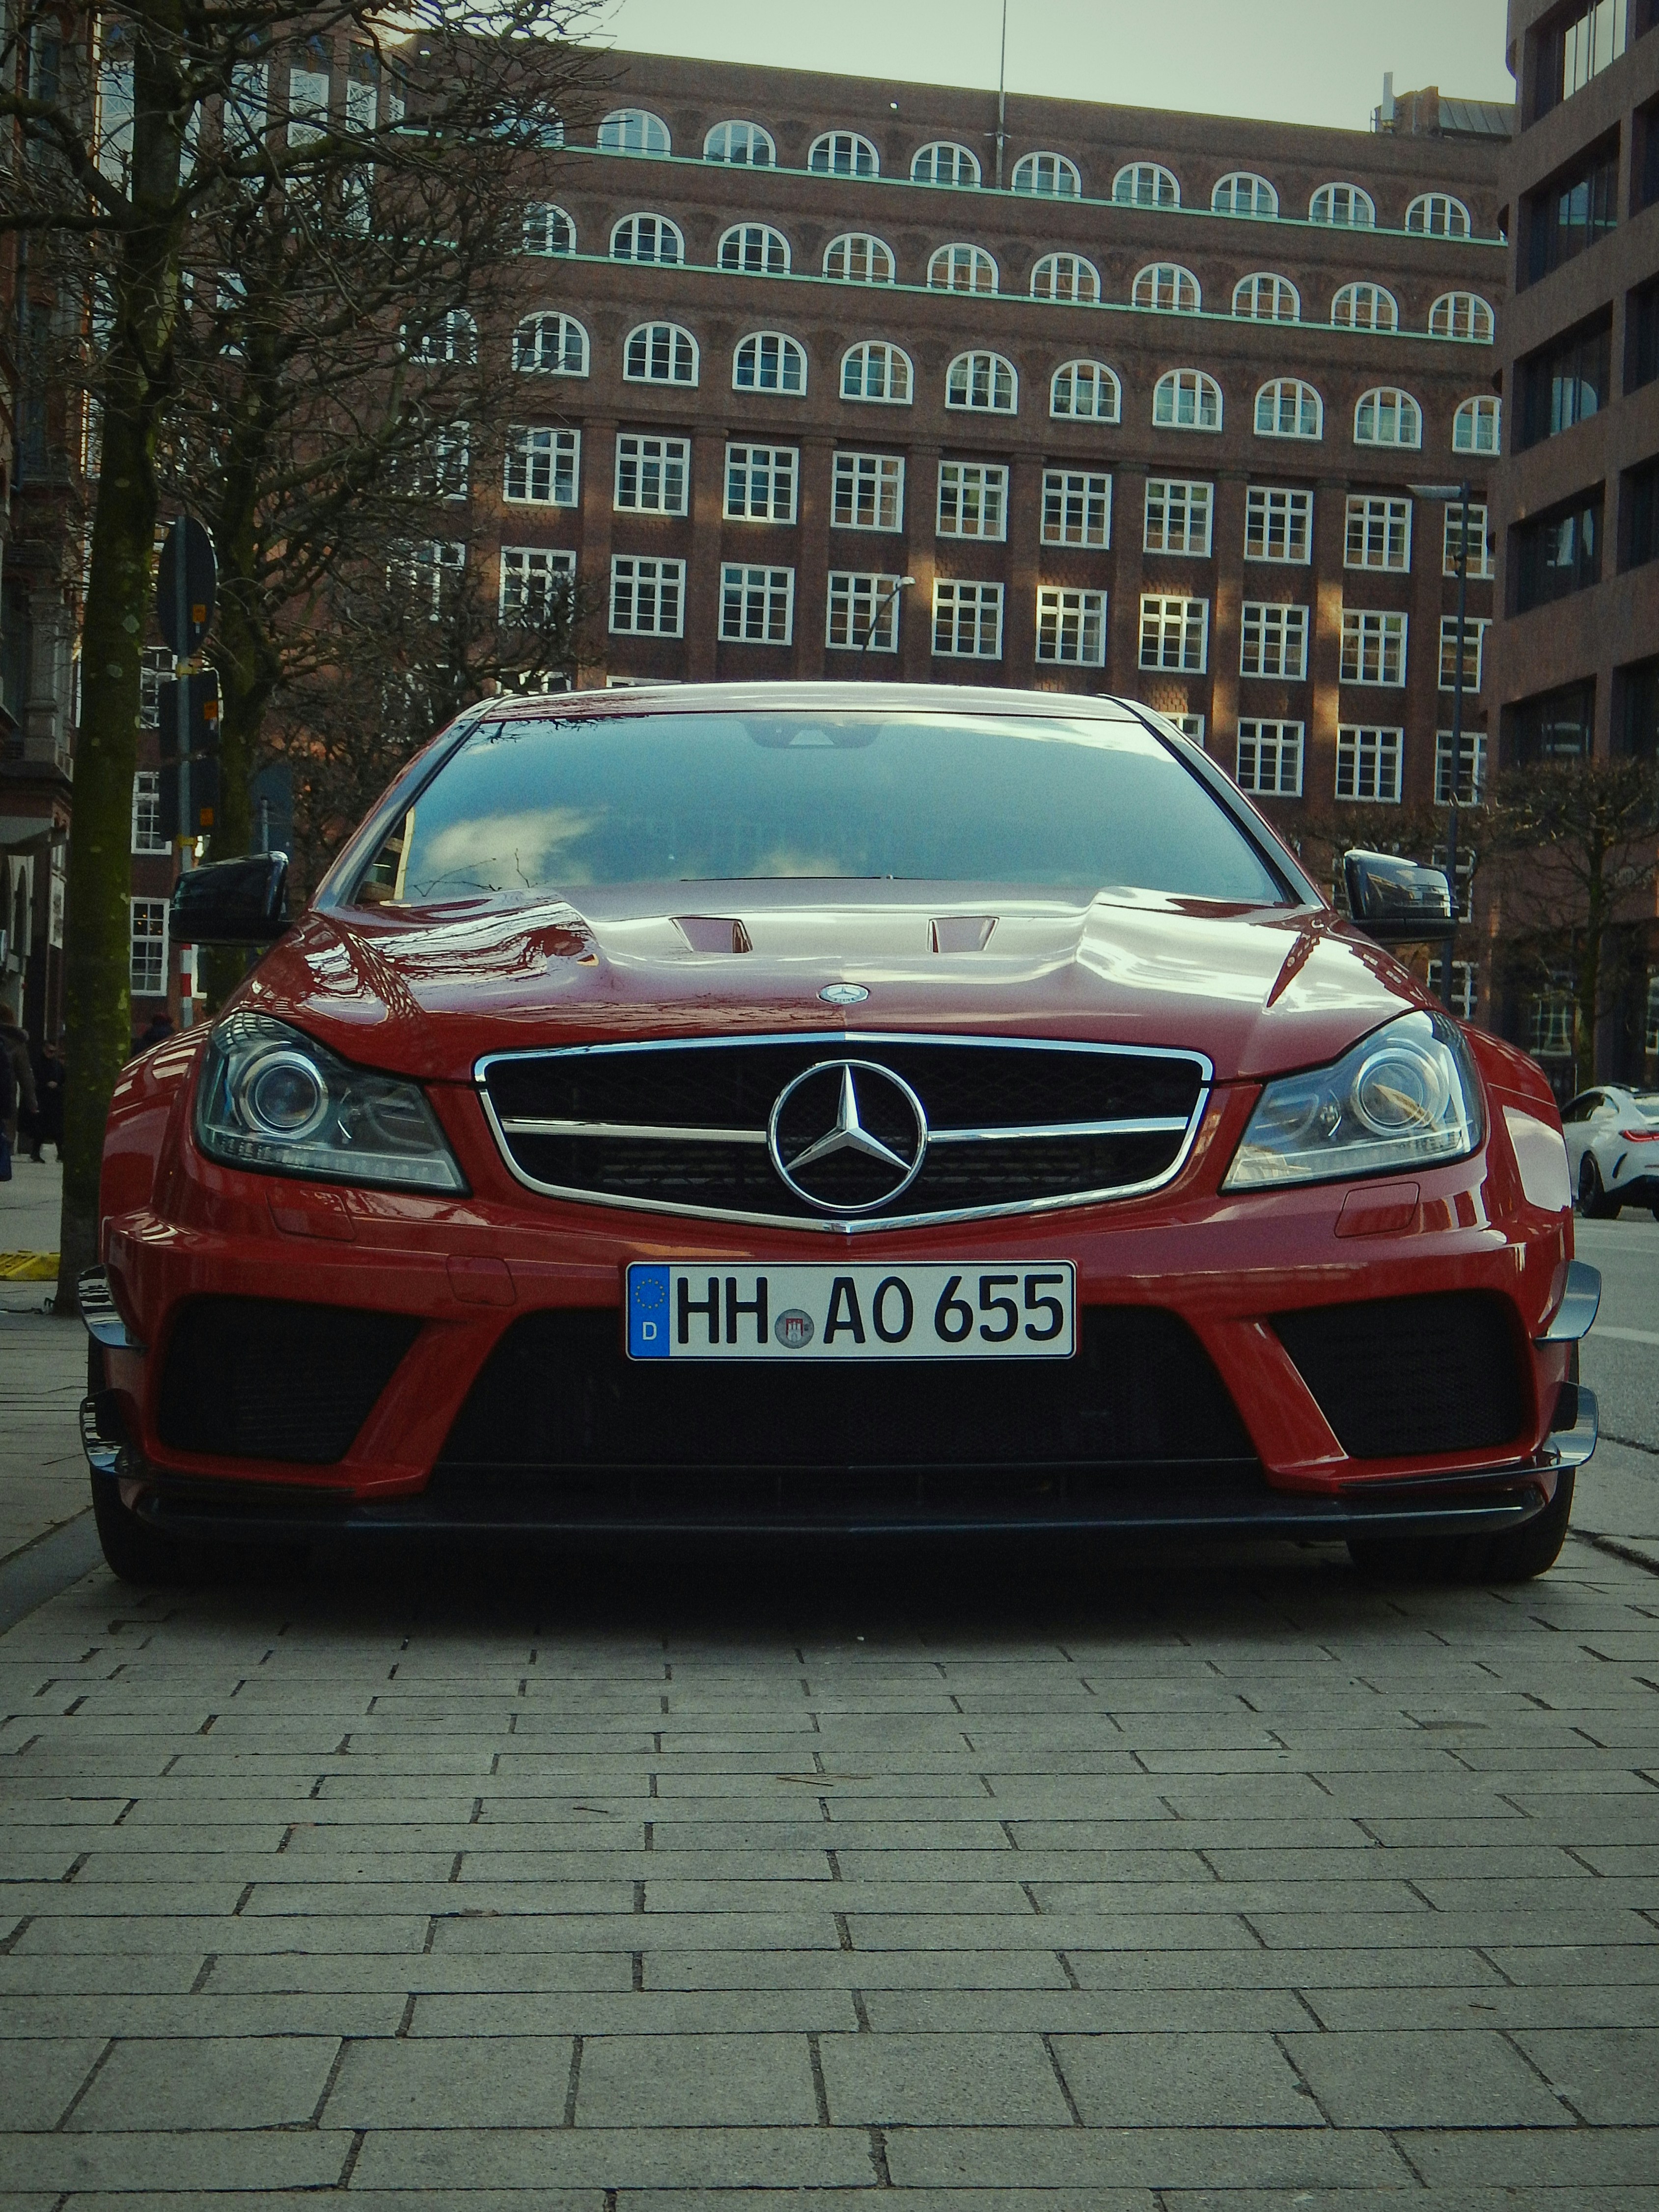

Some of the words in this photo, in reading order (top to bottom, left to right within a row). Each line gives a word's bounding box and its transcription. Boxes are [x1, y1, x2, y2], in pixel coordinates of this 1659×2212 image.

[642, 1321, 657, 1340] D
[677, 1276, 768, 1344] HH
[823, 1276, 913, 1344] AO
[934, 1274, 1064, 1343] 655
